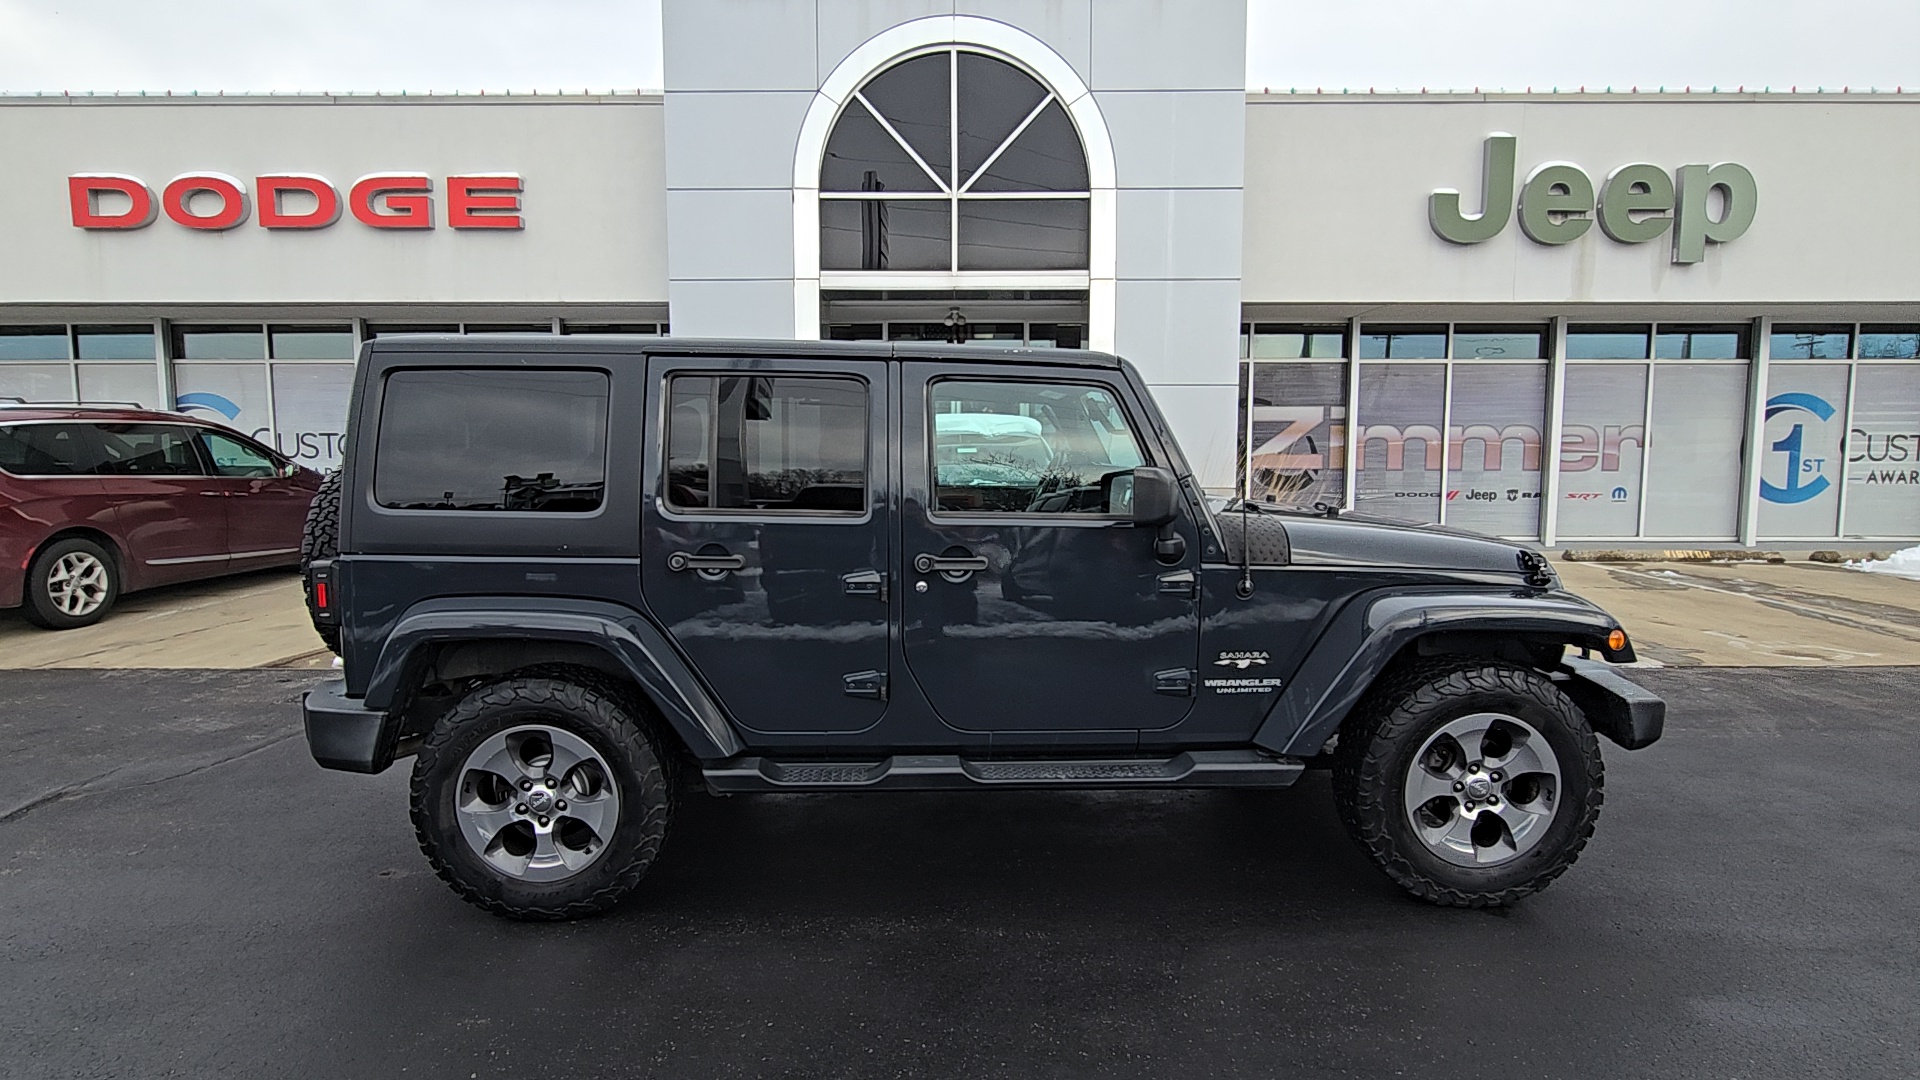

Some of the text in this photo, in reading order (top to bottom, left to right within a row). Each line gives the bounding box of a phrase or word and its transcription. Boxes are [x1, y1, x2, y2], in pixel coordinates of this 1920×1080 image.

[68, 173, 526, 230] DODGE
[1428, 133, 1757, 264] Jeep
[1251, 405, 1652, 472] Zimmer
[1465, 488, 1497, 502] Jeep
[1565, 493, 1603, 501] SRT
[1663, 549, 1712, 559] VISITOR
[1219, 651, 1270, 659] SAHARA
[1204, 679, 1282, 687] WRANGLER
